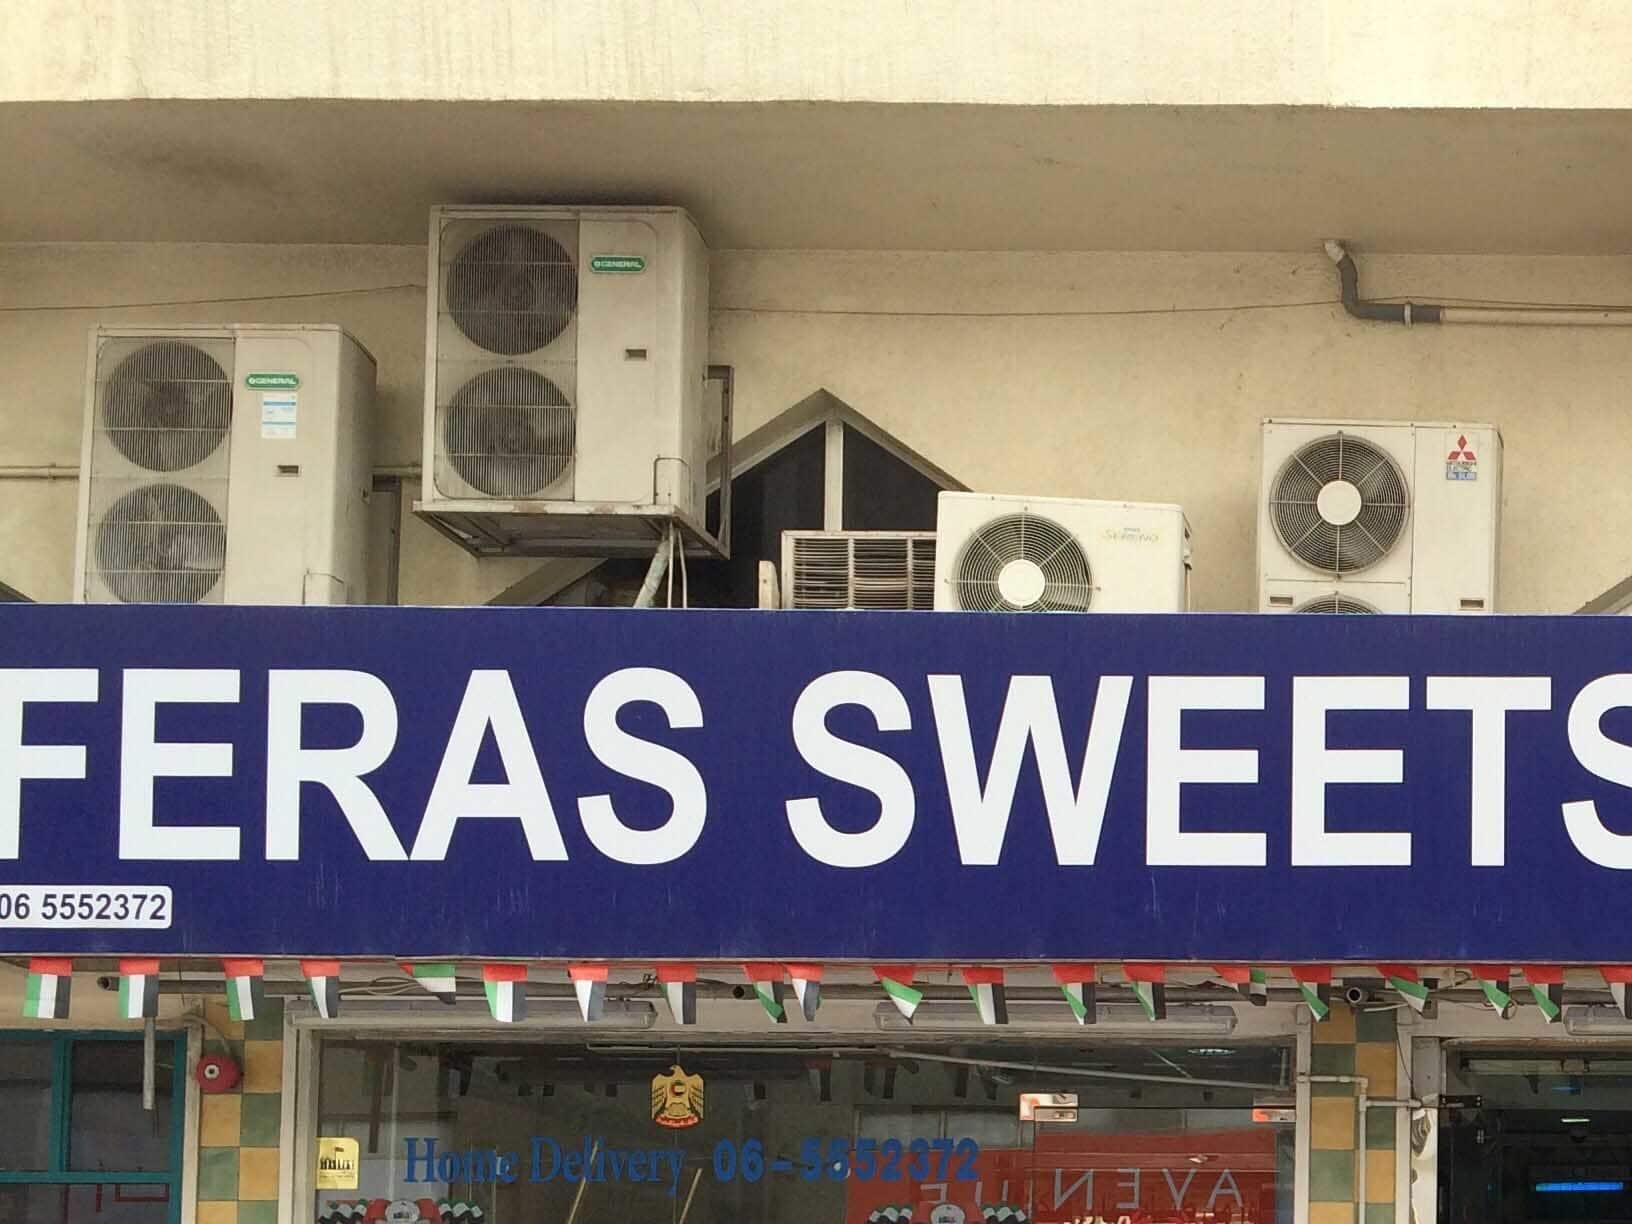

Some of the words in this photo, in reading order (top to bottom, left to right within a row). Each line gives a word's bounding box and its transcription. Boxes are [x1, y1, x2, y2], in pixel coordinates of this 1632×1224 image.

[0, 668, 706, 864] FERAS
[0, 894, 30, 920] 06
[41, 893, 166, 920] 5552372
[404, 1136, 519, 1185] Home
[529, 1135, 686, 1196] Delivery
